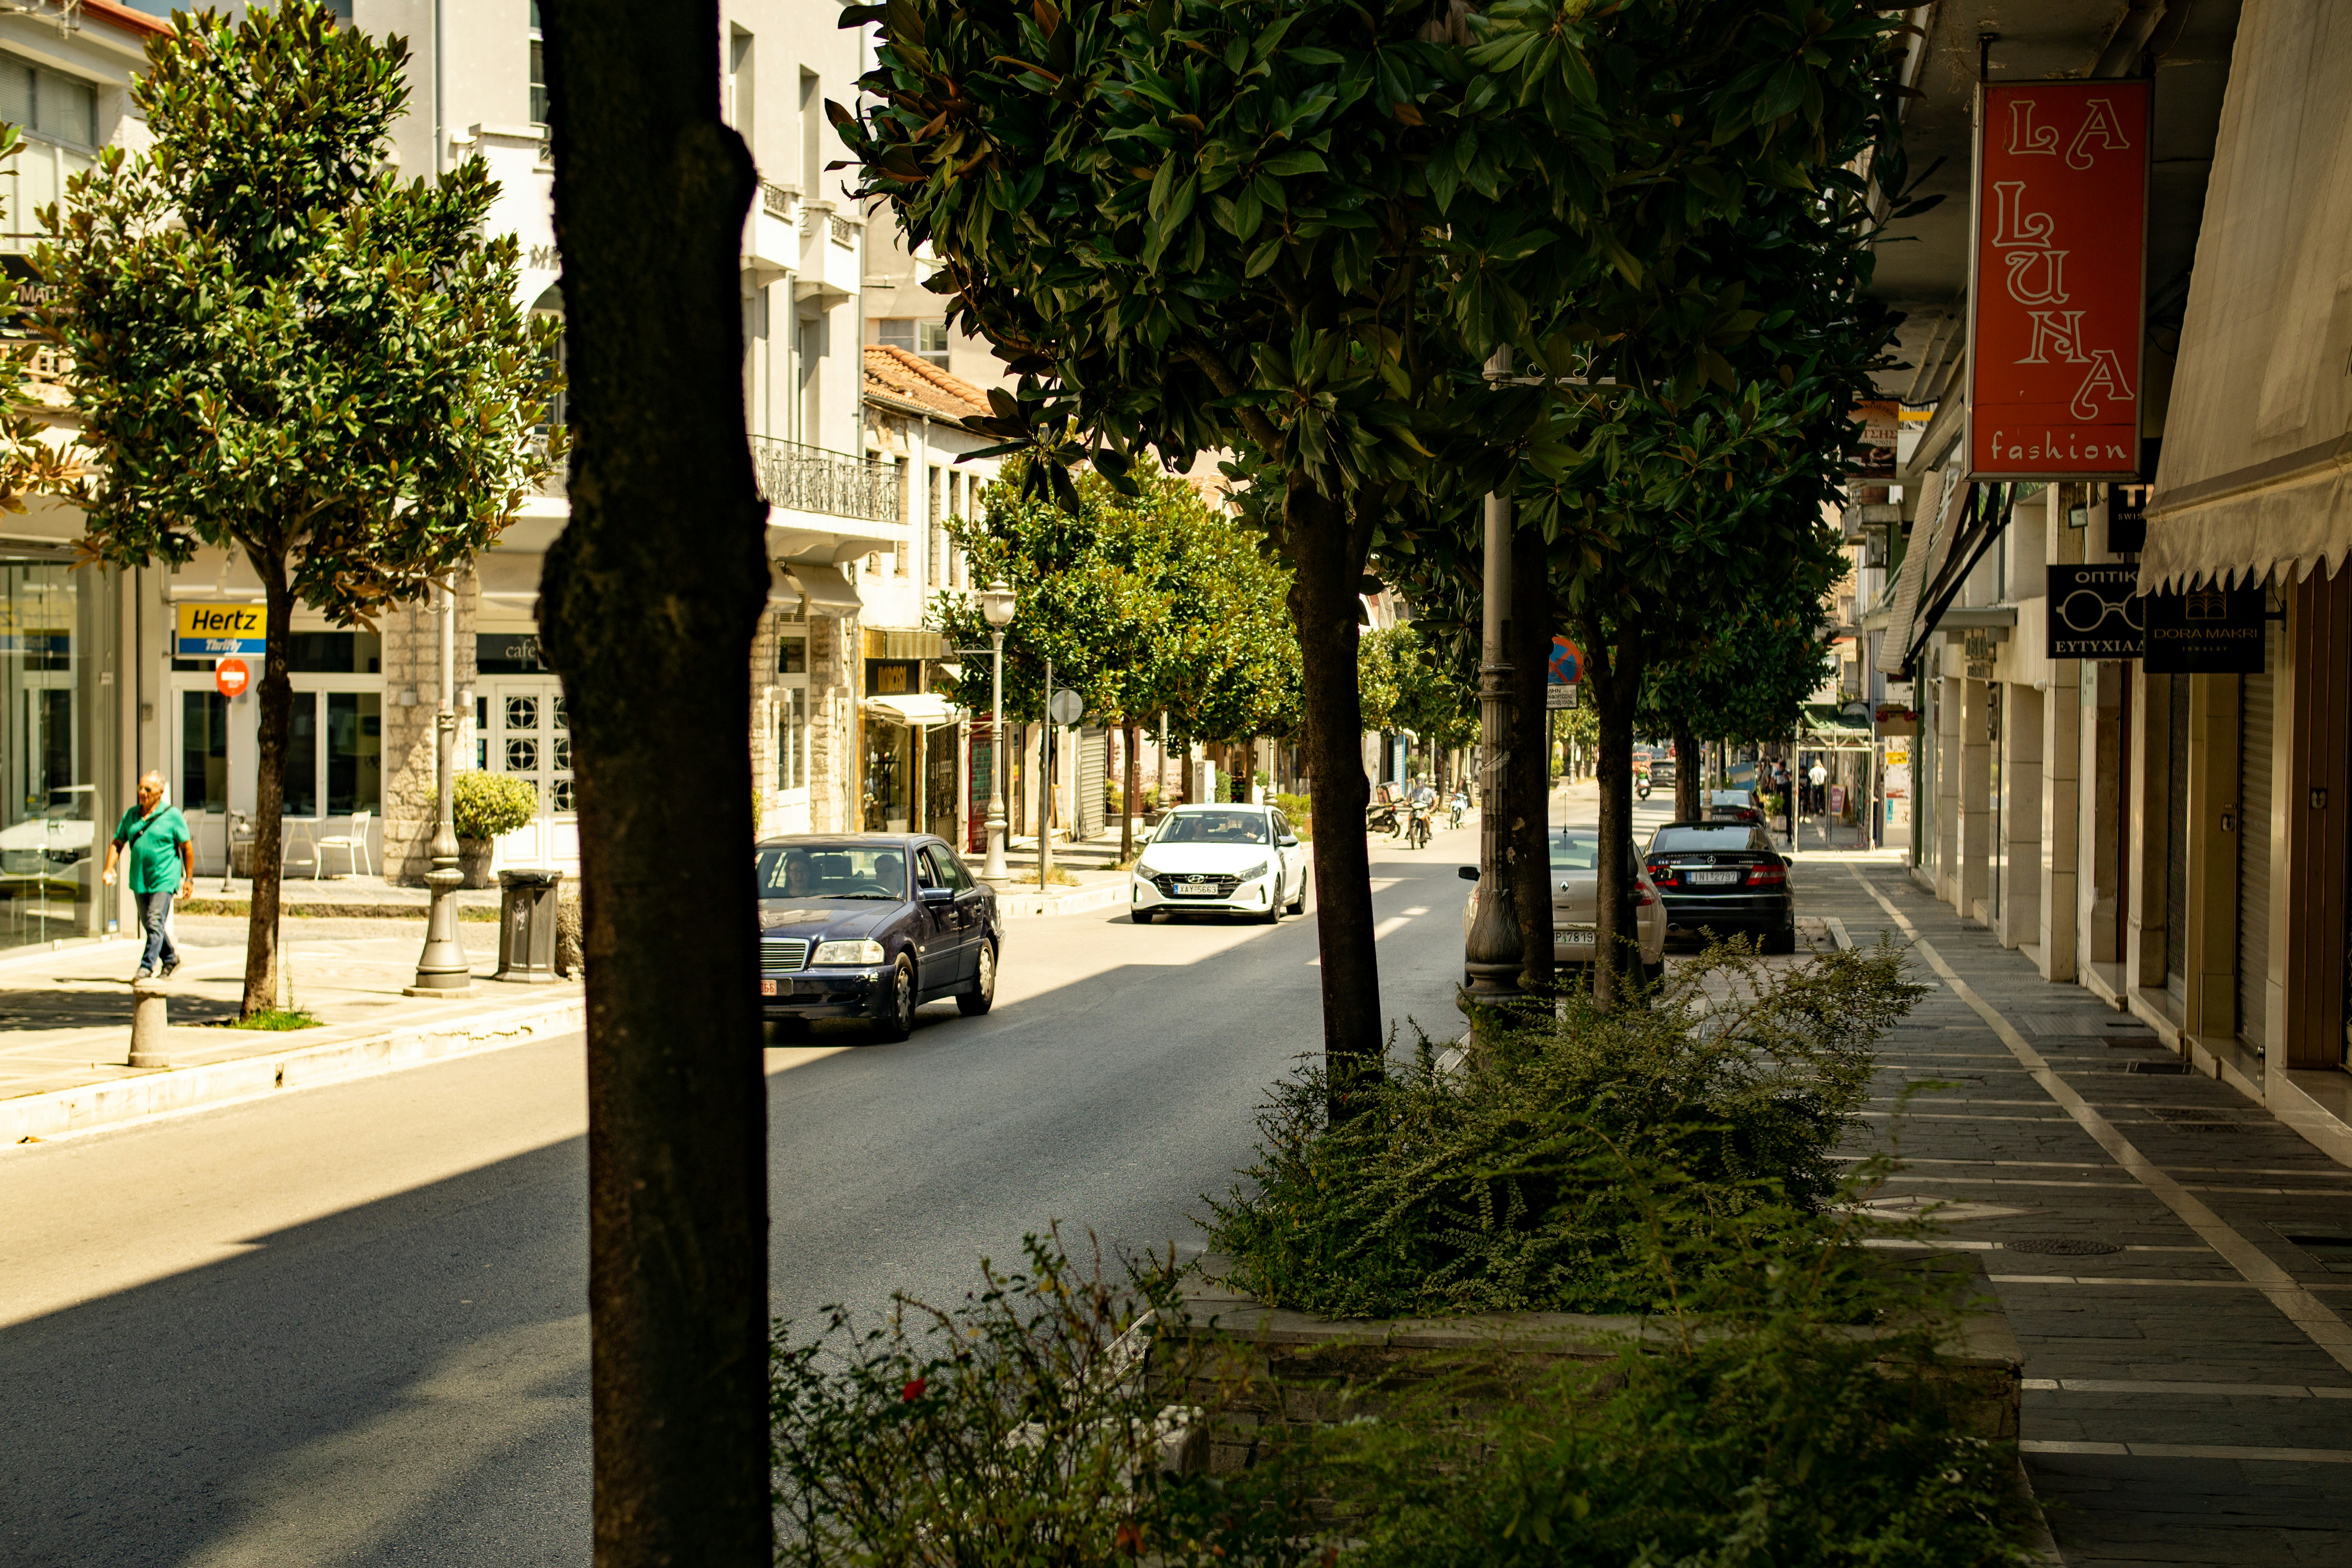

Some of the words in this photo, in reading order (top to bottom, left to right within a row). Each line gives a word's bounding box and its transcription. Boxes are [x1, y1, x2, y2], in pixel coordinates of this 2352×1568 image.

[2008, 98, 2130, 170] LA
[1992, 181, 2135, 420] LUNA
[1992, 431, 2126, 460] fashion
[192, 610, 258, 630] Hertz
[2154, 628, 2202, 638] DORA
[2206, 628, 2257, 638] MAKRI
[206, 639, 242, 653] Thrifty
